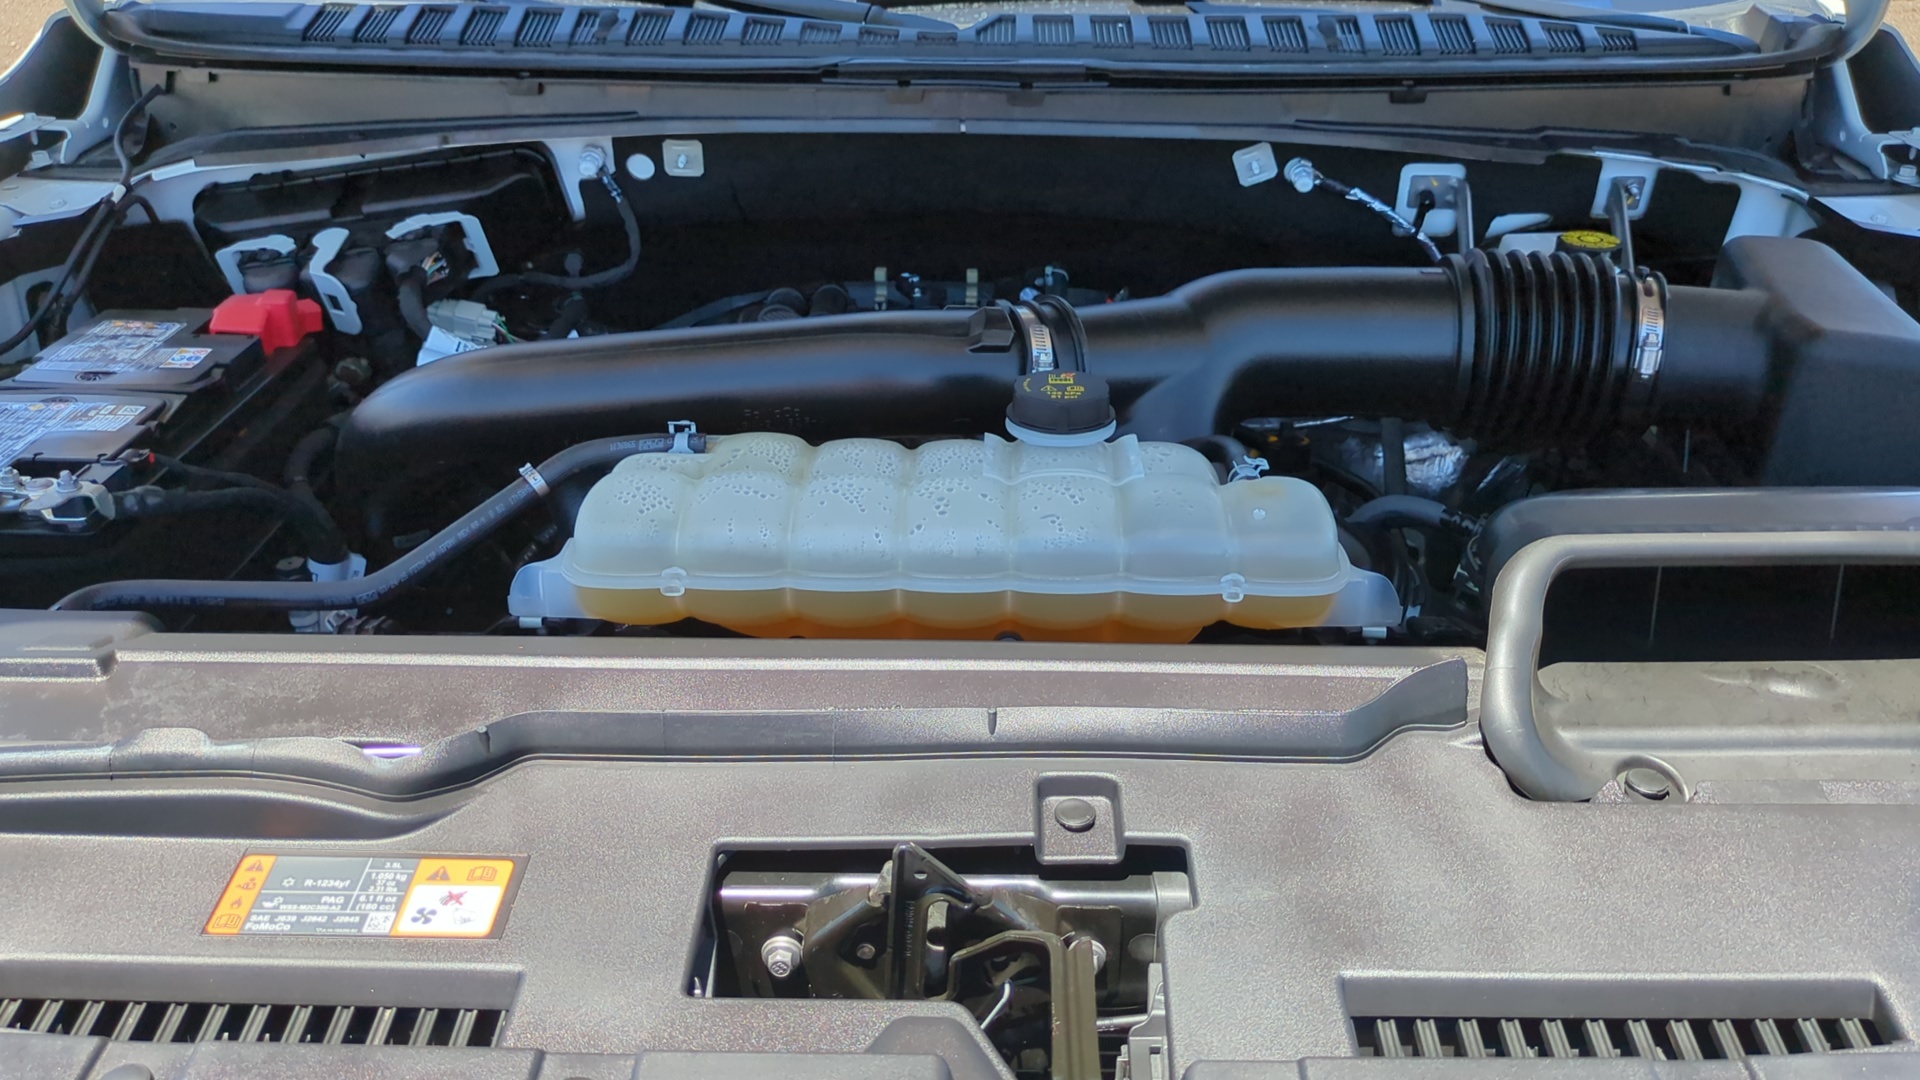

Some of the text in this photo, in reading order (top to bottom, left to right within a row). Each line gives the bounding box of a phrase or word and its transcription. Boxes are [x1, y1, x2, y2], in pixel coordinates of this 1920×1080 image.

[371, 872, 408, 882] 1.050 kg
[303, 878, 351, 889] R-1234yf
[320, 896, 345, 905] PAG
[378, 903, 396, 911] cc)
[249, 914, 271, 923] SAE
[274, 914, 297, 923] J639
[244, 922, 292, 932] FoMoCo
